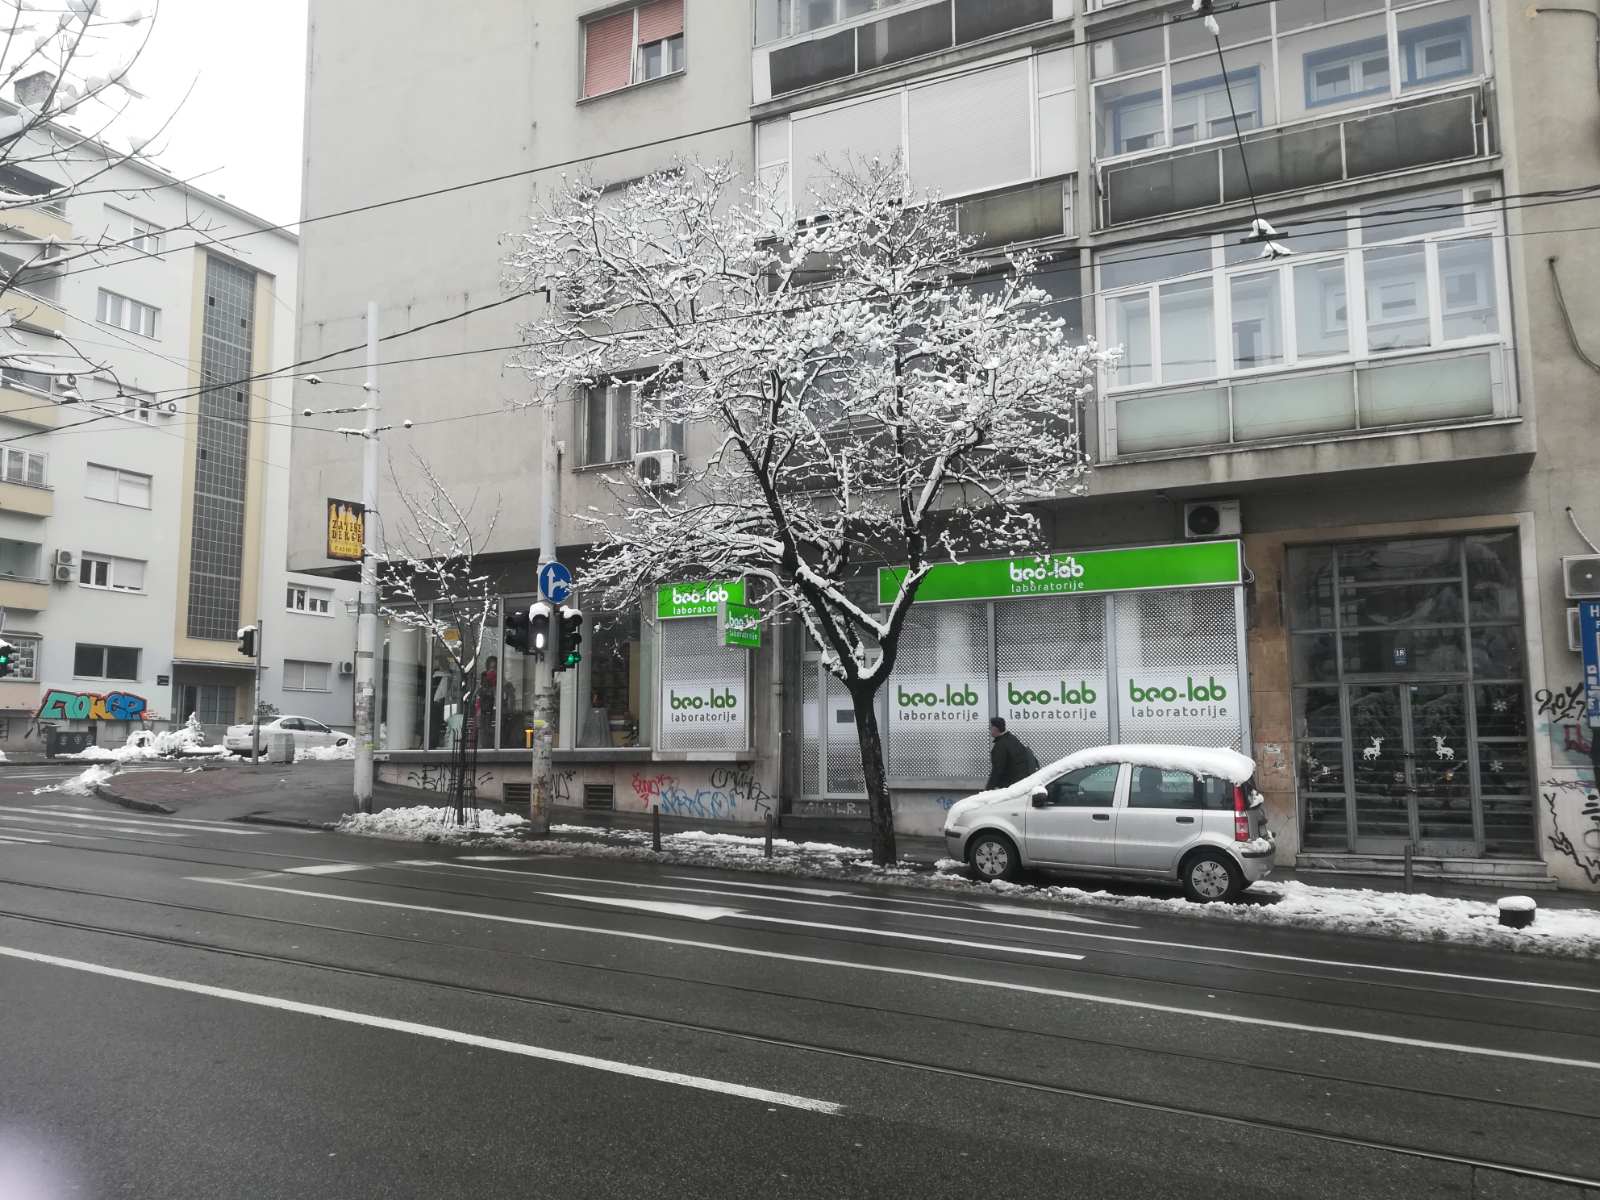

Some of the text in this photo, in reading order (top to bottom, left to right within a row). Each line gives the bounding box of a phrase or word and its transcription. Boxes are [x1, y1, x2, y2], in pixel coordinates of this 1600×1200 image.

[1009, 559, 1085, 582] beo-lab
[1011, 580, 1085, 593] laboratorije
[897, 683, 979, 707] beo-lab
[1007, 681, 1097, 706] beo-lab
[1129, 676, 1227, 703] beo-lab
[670, 688, 737, 710] beo-lab
[671, 712, 737, 723] laboratorije
[899, 708, 979, 721] laboratorije
[1010, 706, 1097, 721] laboratorije
[1131, 704, 1228, 719] laboratorije
